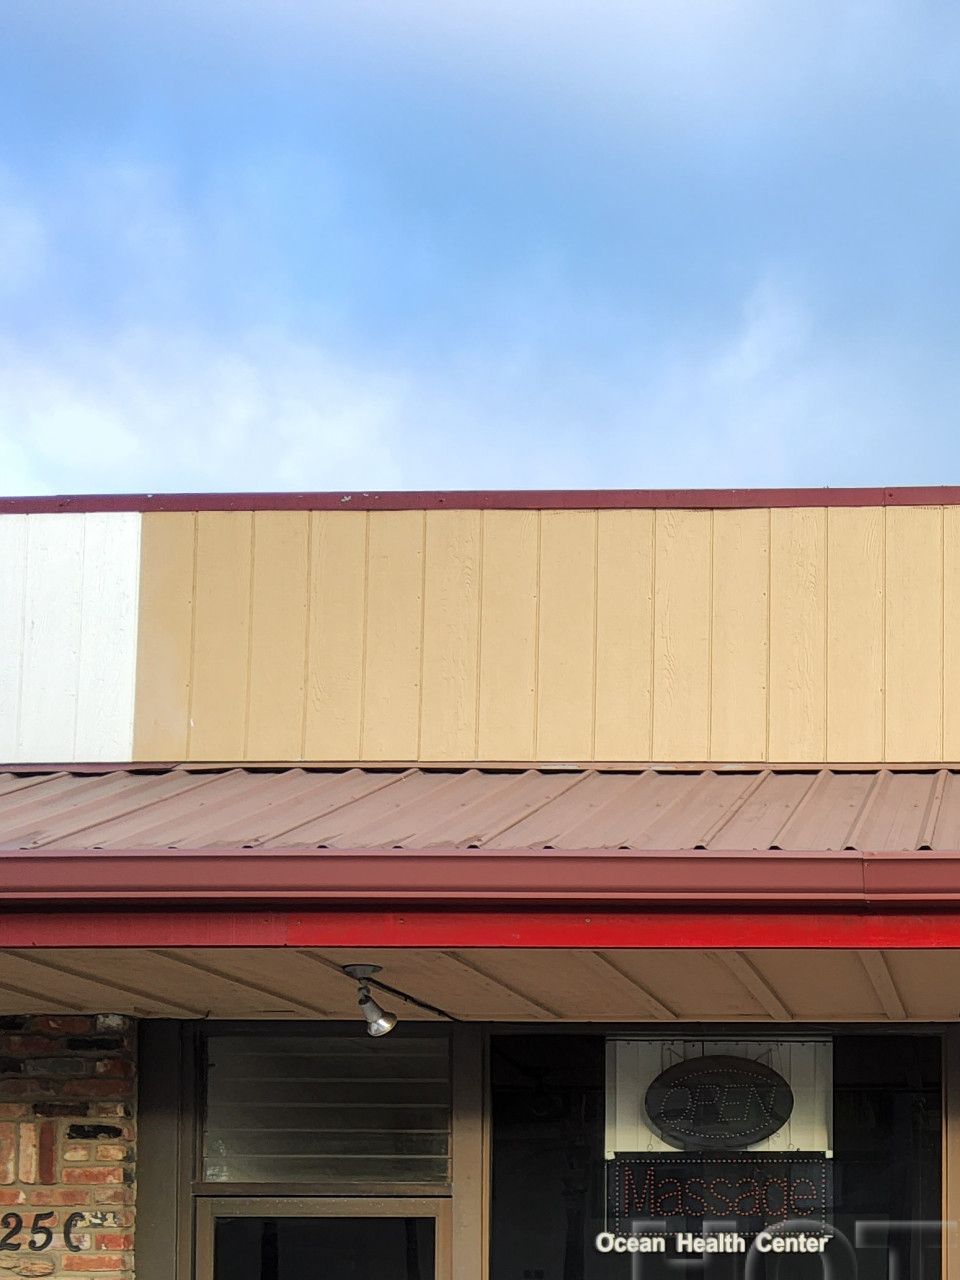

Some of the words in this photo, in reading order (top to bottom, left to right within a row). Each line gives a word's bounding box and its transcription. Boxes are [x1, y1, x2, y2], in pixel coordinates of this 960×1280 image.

[659, 1082, 777, 1124] OPEN
[623, 1166, 817, 1234] Massage
[596, 1232, 665, 1253] Ocean
[676, 1233, 746, 1253] Health
[755, 1232, 828, 1253] Center
